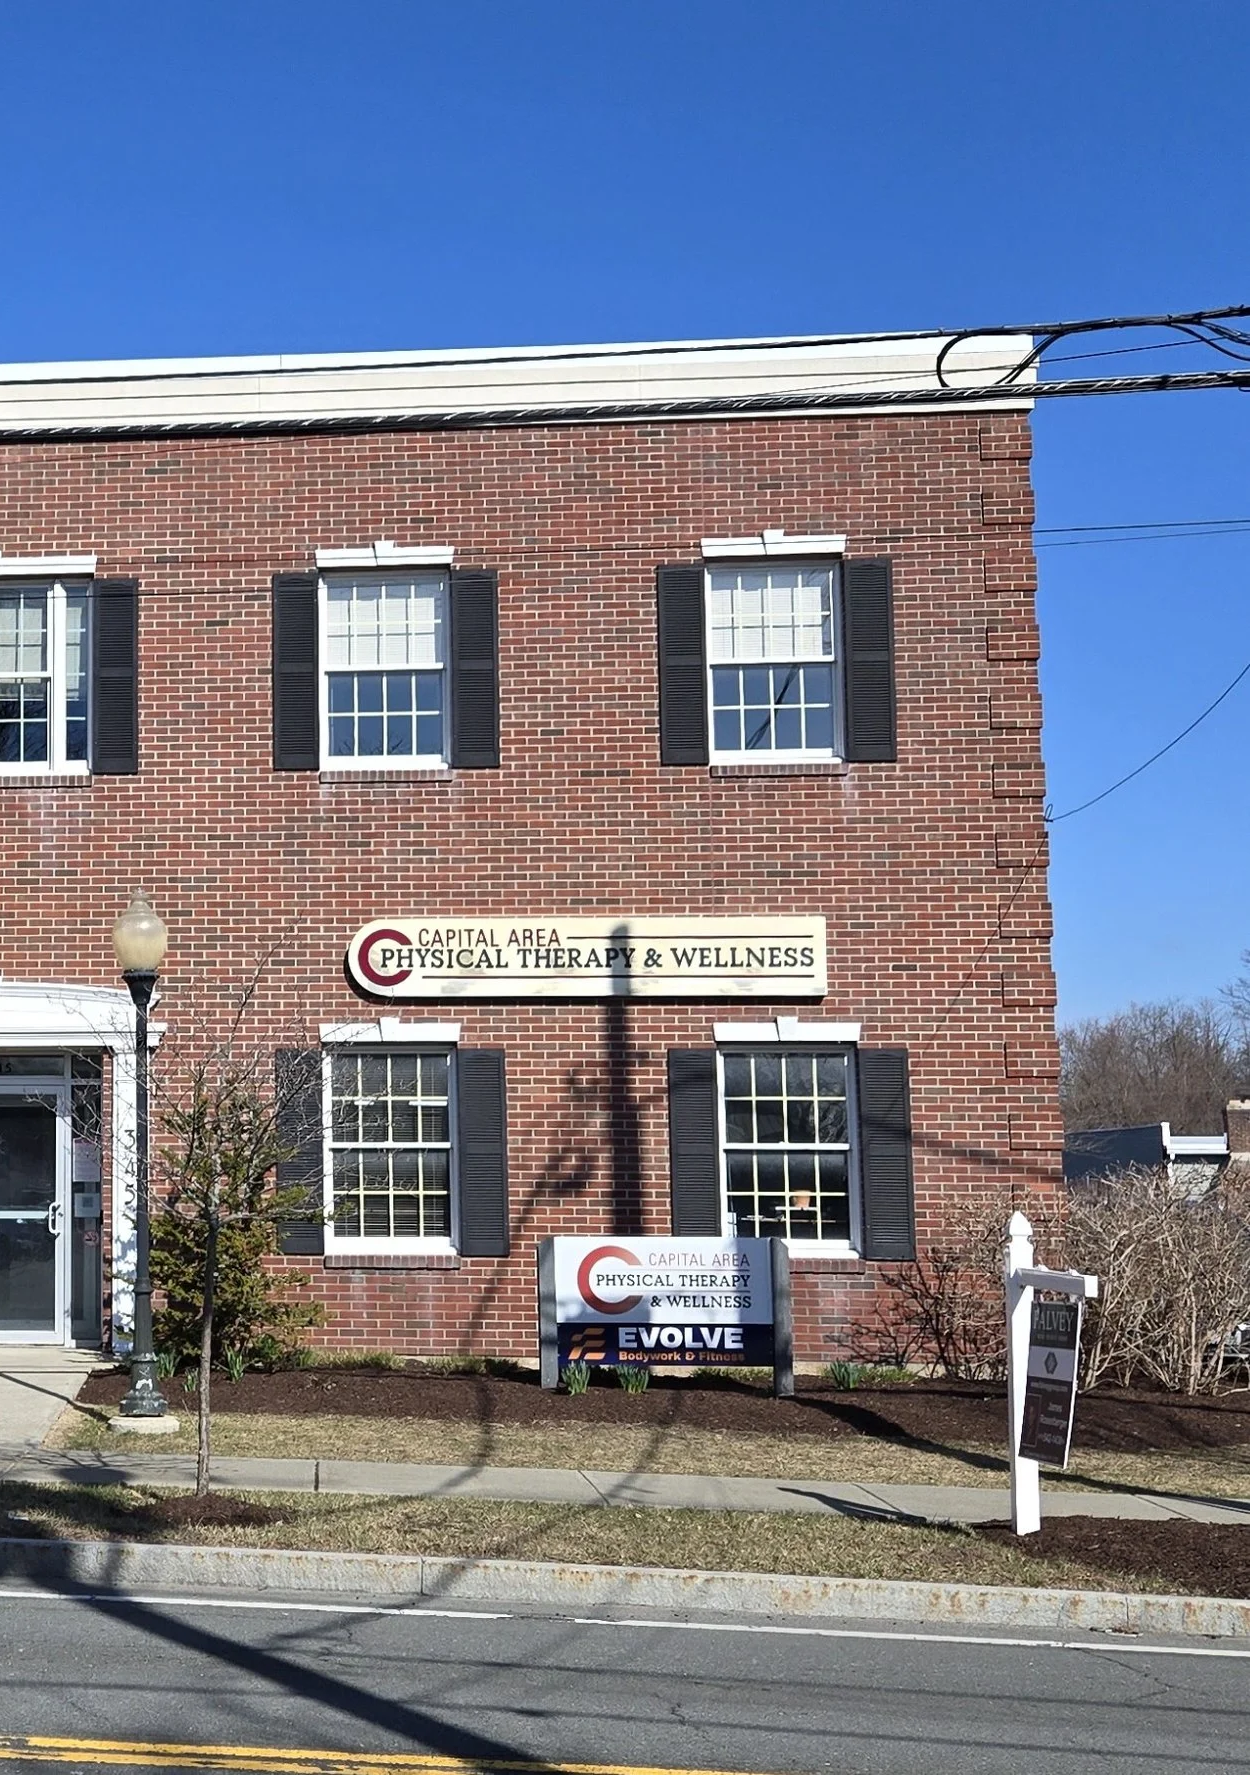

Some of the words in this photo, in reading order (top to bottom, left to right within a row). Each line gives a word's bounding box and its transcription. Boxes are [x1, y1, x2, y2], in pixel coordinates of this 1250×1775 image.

[418, 928, 499, 947] CAPITAL
[507, 928, 561, 947] AREA
[380, 948, 509, 969] PHYSICAL
[517, 947, 635, 968] THERAPY
[643, 947, 663, 967] &
[670, 946, 815, 967] WELLNESS
[649, 1253, 706, 1267] CAPITAL
[712, 1253, 750, 1267] AREA
[596, 1274, 674, 1288] PHYSICAL
[679, 1274, 751, 1288] THERAPY
[650, 1296, 662, 1308] &
[666, 1295, 752, 1309] WELLNESS
[618, 1327, 744, 1349] EVOLVE
[619, 1351, 681, 1363] Bodywork
[685, 1351, 695, 1361] &
[699, 1351, 746, 1362] Fitness
